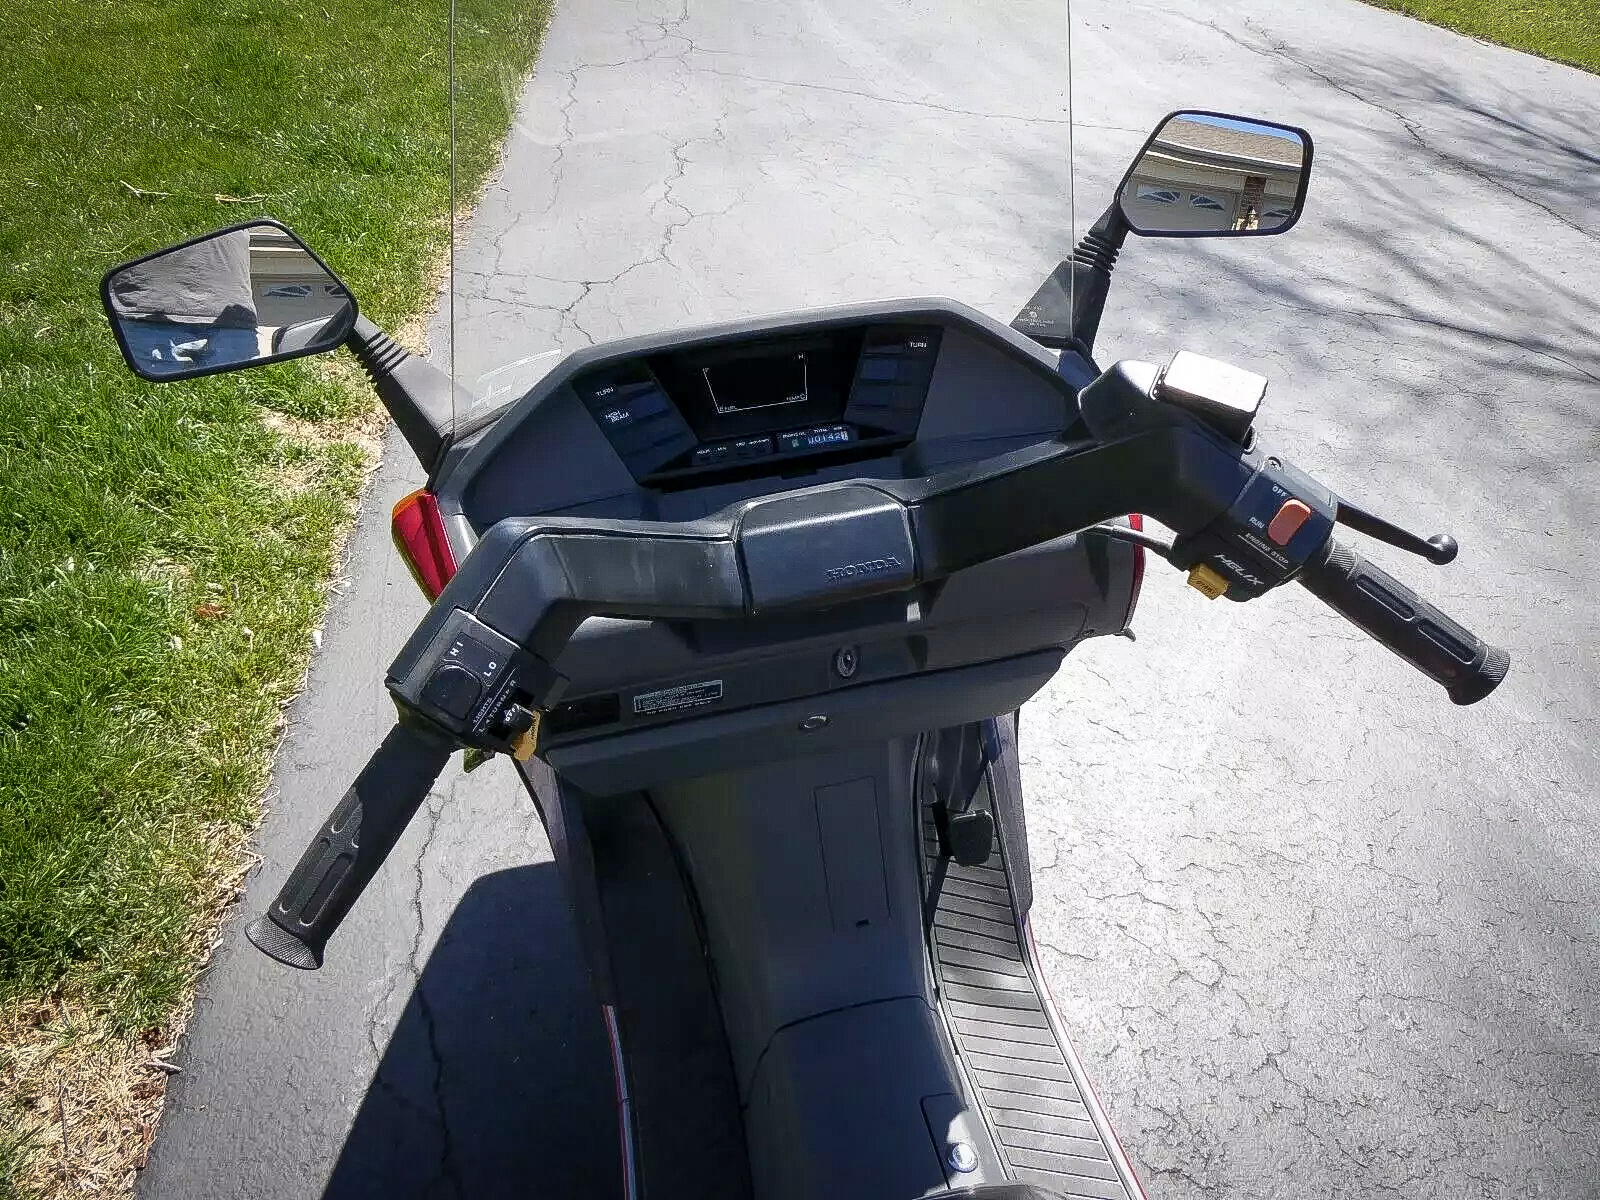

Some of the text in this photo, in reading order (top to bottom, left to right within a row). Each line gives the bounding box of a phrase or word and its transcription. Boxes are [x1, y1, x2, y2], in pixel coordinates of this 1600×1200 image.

[1249, 516, 1265, 530] RUN
[1270, 549, 1289, 565] STOP
[825, 556, 902, 581] HONDA
[1213, 554, 1265, 586] HELIX
[450, 641, 464, 657] HI
[483, 661, 497, 677] LO
